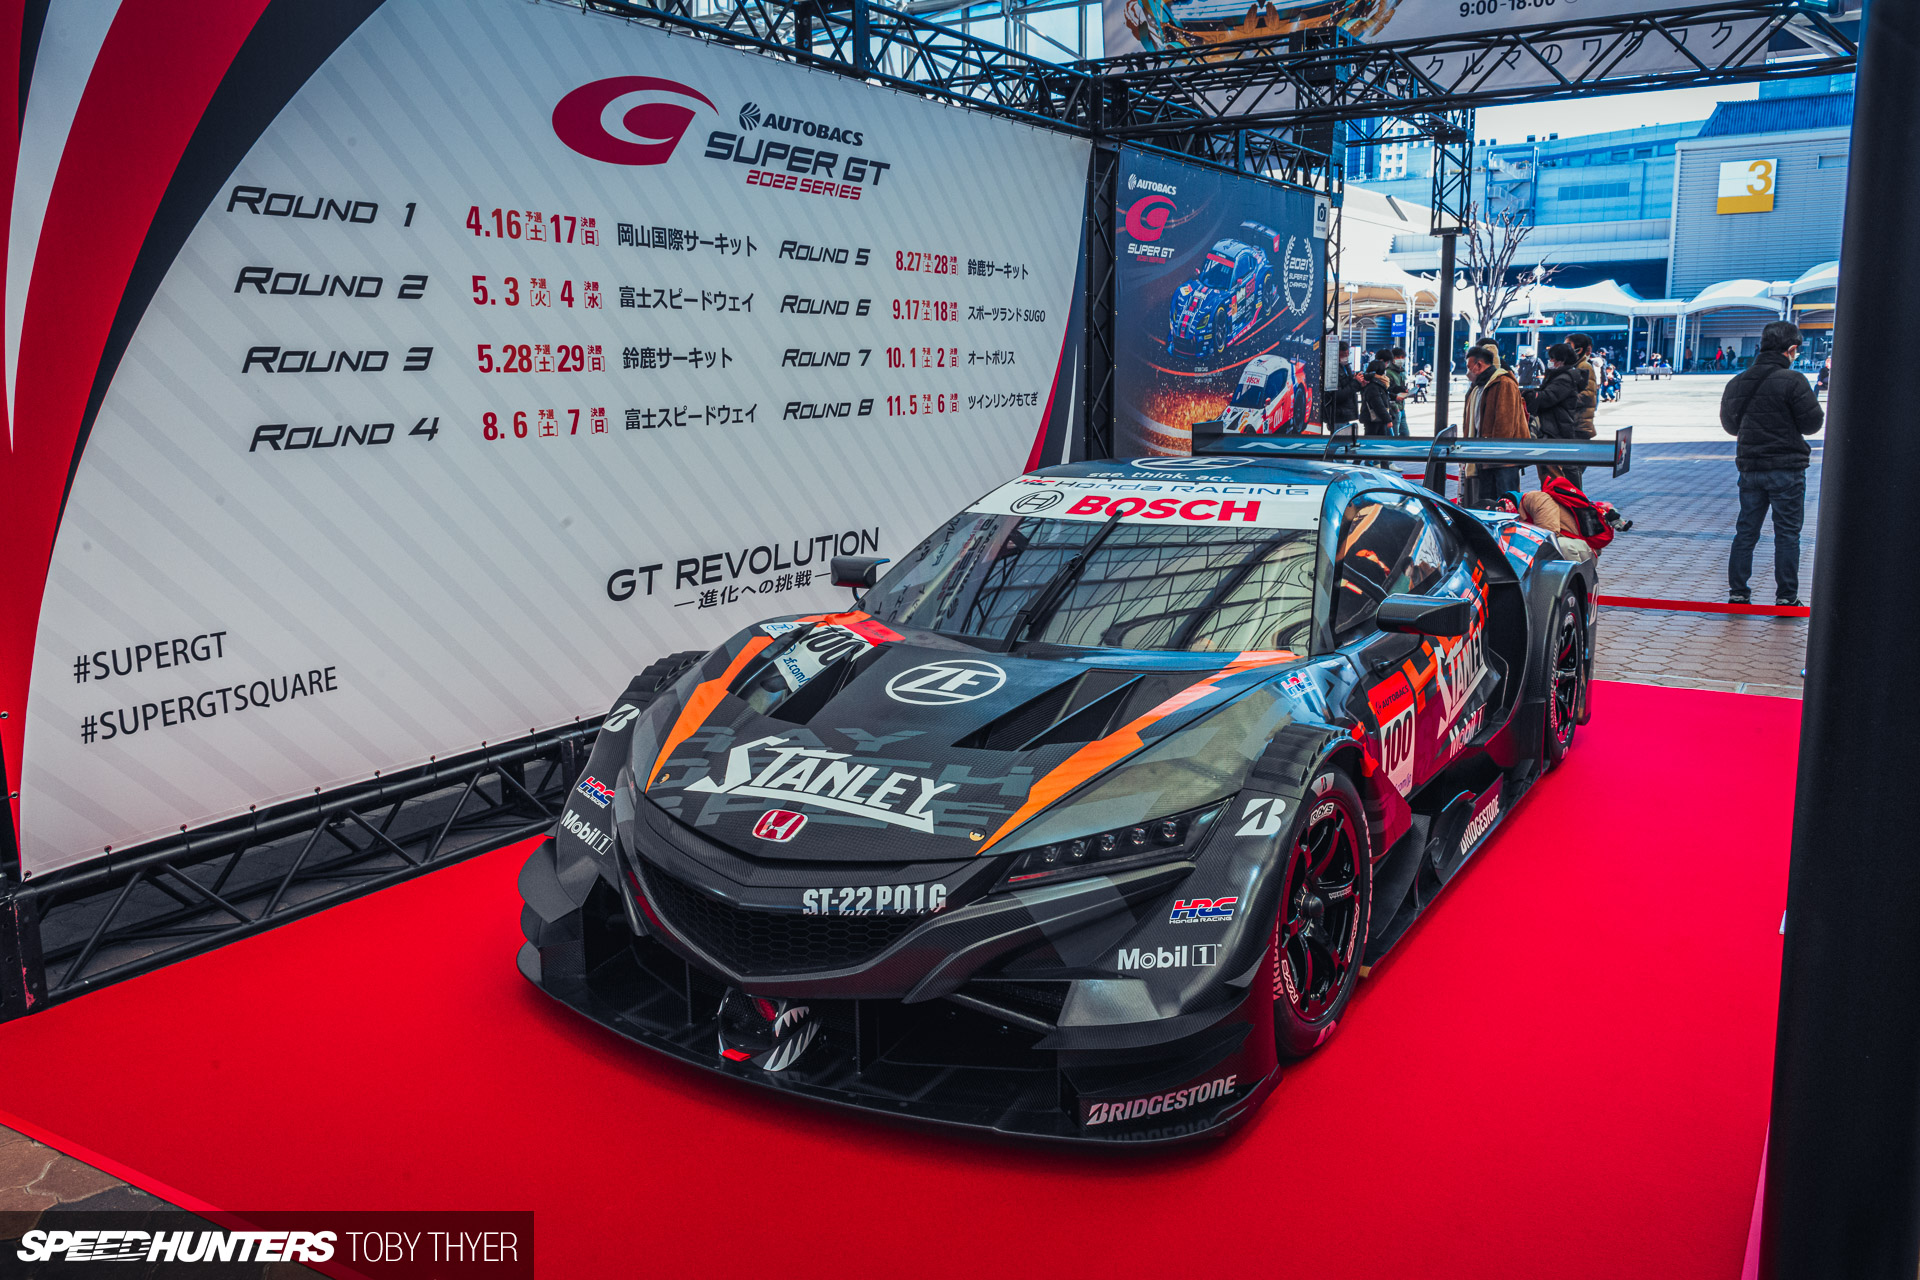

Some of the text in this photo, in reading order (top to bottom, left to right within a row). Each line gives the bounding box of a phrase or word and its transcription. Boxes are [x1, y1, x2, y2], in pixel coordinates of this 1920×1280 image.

[762, 113, 864, 147] AUTOBACS
[704, 131, 891, 186] SUPER GT
[746, 169, 862, 200] 2022 SERIES
[1136, 179, 1177, 195] AUTOBACS
[1745, 158, 1774, 198] 3
[404, 203, 416, 227] 1
[466, 206, 521, 239] 4.16
[551, 214, 576, 243] 17
[617, 223, 757, 257] 岡山国際サーキット
[855, 248, 871, 266] 5
[1127, 242, 1175, 258] SUPER GT
[1289, 257, 1309, 271] 2021
[896, 251, 921, 271] 8.27
[934, 255, 948, 274] 28
[968, 259, 1028, 280] 鈴鹿サーキット
[397, 275, 428, 299] 2
[561, 280, 574, 308] 4
[619, 286, 753, 312] 富士スピードウェイ
[856, 299, 871, 316] 6
[893, 299, 919, 320] 9.17
[934, 301, 947, 321] 18
[968, 305, 1022, 322] スポーツランド
[1024, 310, 1045, 322] SUGO
[1555, 313, 1566, 326] 6
[403, 347, 433, 371] 3
[478, 344, 532, 373] 5.28
[557, 345, 584, 372] 29
[623, 347, 732, 369] 鈴鹿サーキット
[858, 349, 872, 366] 7
[937, 348, 944, 367] 2
[968, 350, 1015, 365] オートポリス
[858, 399, 874, 416] 8
[938, 394, 945, 413] 6
[968, 392, 1038, 409] ツインリンクもてぎ
[408, 417, 439, 441] 4
[568, 409, 579, 435] 7
[625, 404, 757, 430] 富士スピードウェイ
[1055, 481, 1162, 492] Honda
[1170, 485, 1309, 496] RACING
[1131, 471, 1189, 480] think.
[1196, 474, 1235, 483] act.
[1065, 494, 1261, 522] BOSCH
[606, 563, 663, 602] GT
[675, 527, 879, 590] REVOLUTION
[74, 631, 227, 684] #SUPERGT
[892, 667, 984, 701] ZF
[1434, 622, 1489, 740] STANLEY
[80, 666, 338, 744] #SUPERGTSQUARE
[1382, 684, 1410, 709] AUTOBACS
[1384, 710, 1413, 769] 100
[579, 775, 615, 805] HRC
[684, 736, 958, 834] STANLEY
[561, 809, 601, 846] Mobil
[1459, 794, 1500, 855] BRIDGESTONE
[1169, 896, 1239, 919] HRC
[1117, 946, 1188, 970] Mobil
[1087, 1075, 1236, 1124] BRIDGESTONE
